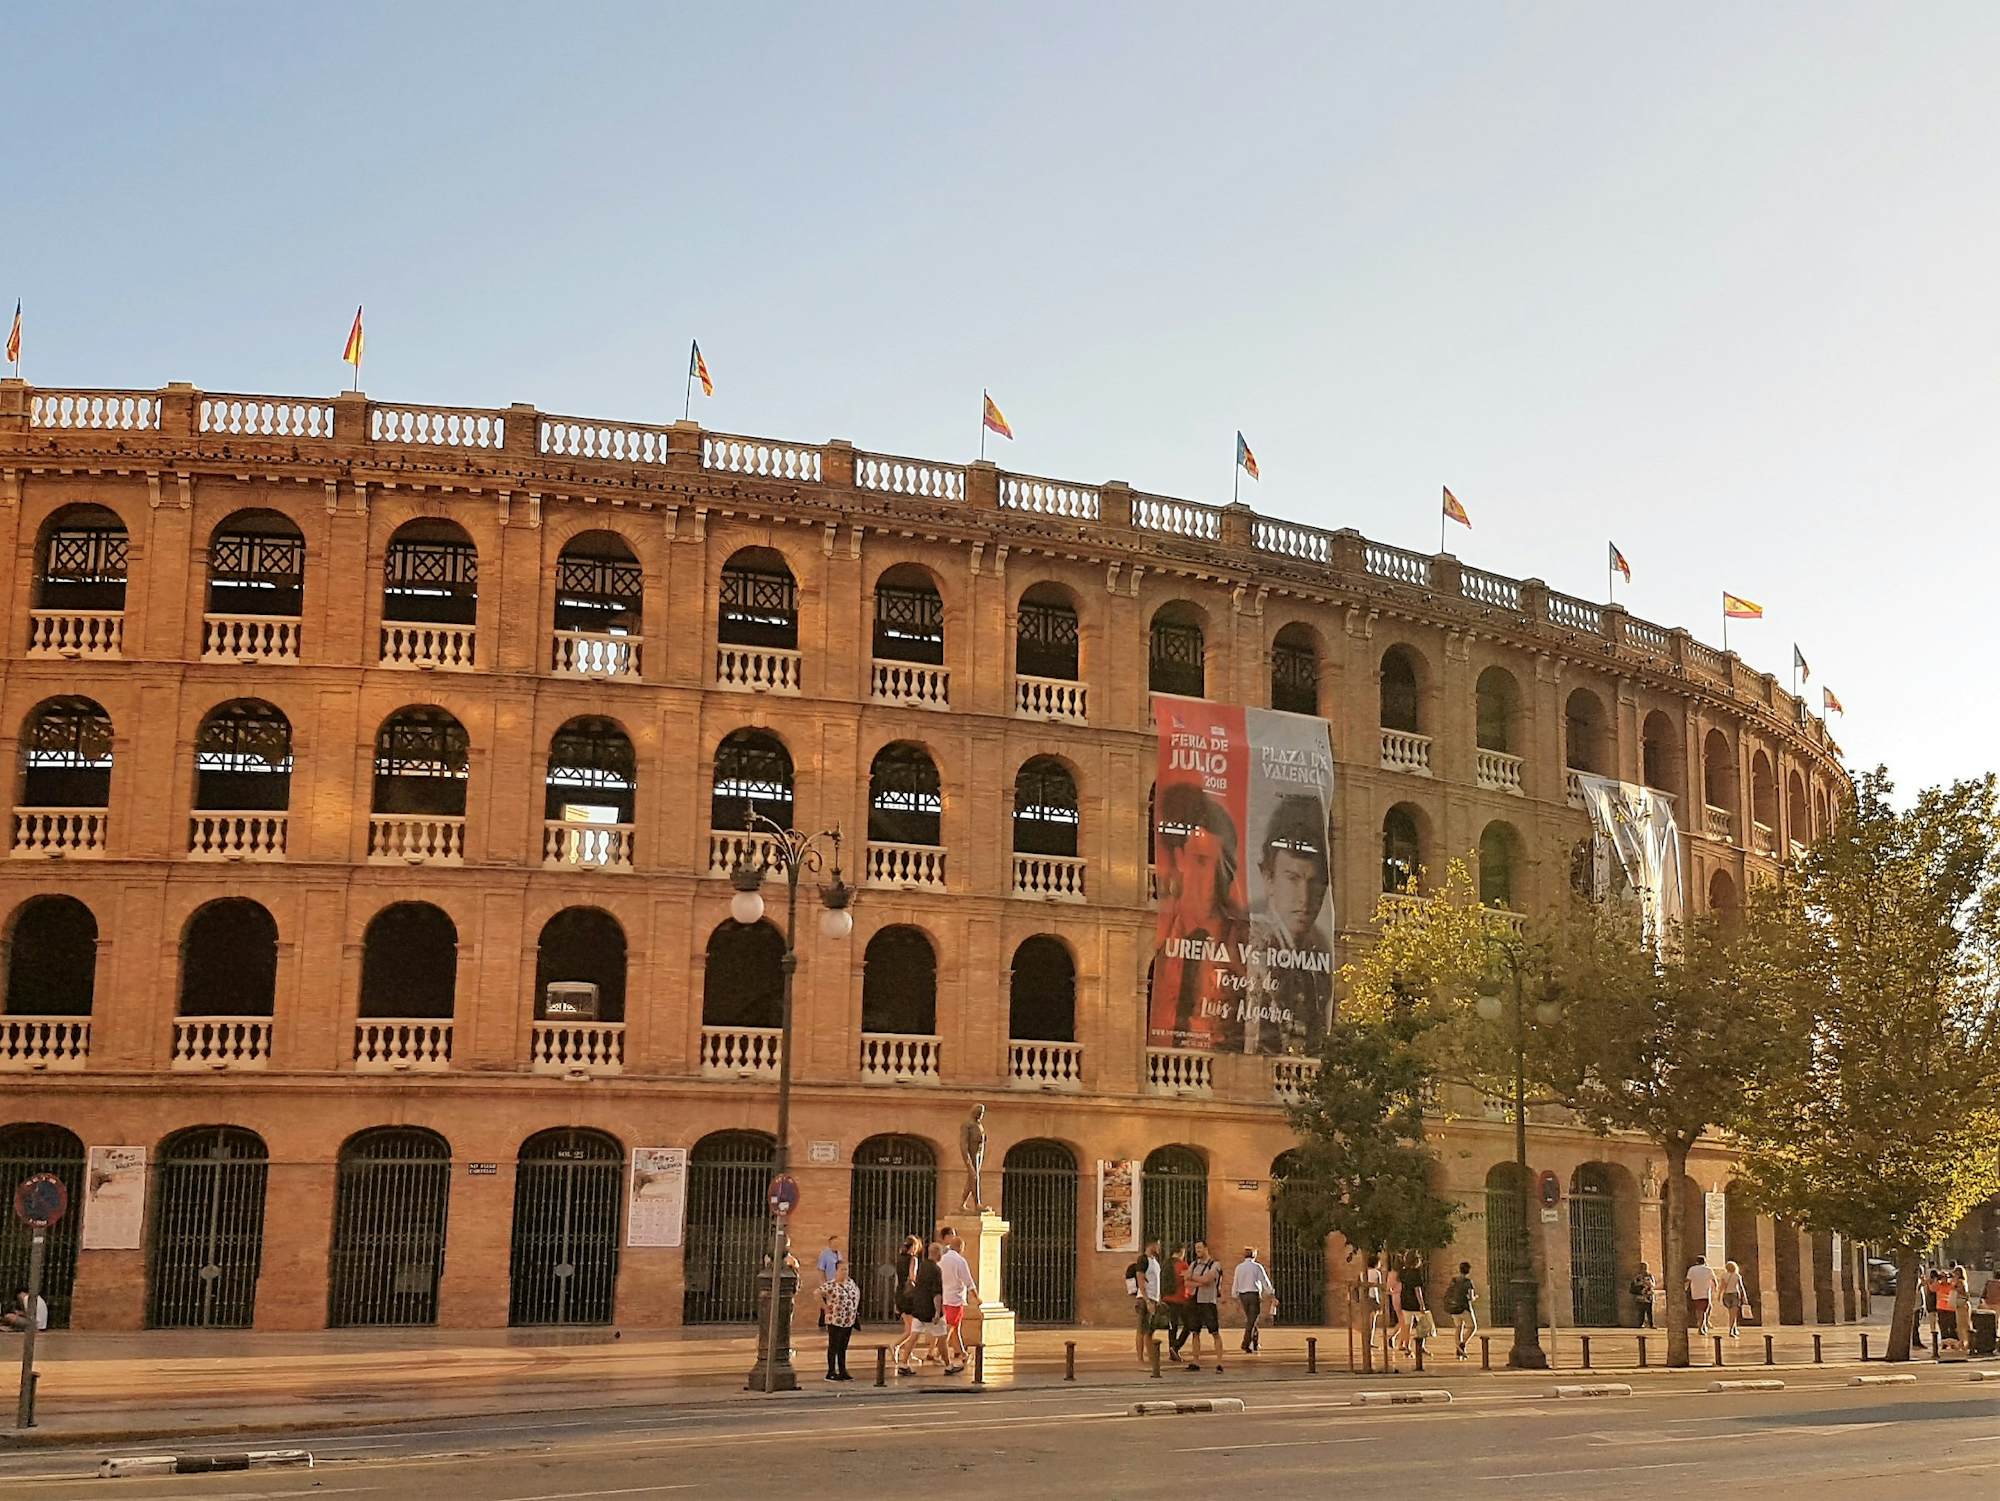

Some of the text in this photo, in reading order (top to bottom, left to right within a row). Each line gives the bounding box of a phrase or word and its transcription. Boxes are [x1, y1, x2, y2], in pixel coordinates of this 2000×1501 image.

[1170, 733, 1229, 752] FERIA DE
[1169, 749, 1228, 774] JULIO
[1262, 746, 1307, 767] PLAZA
[1204, 776, 1228, 790] 2018
[1165, 937, 1231, 963] UREÑA
[1213, 968, 1281, 993] Toros de
[1200, 997, 1294, 1024] Luis Algarra
